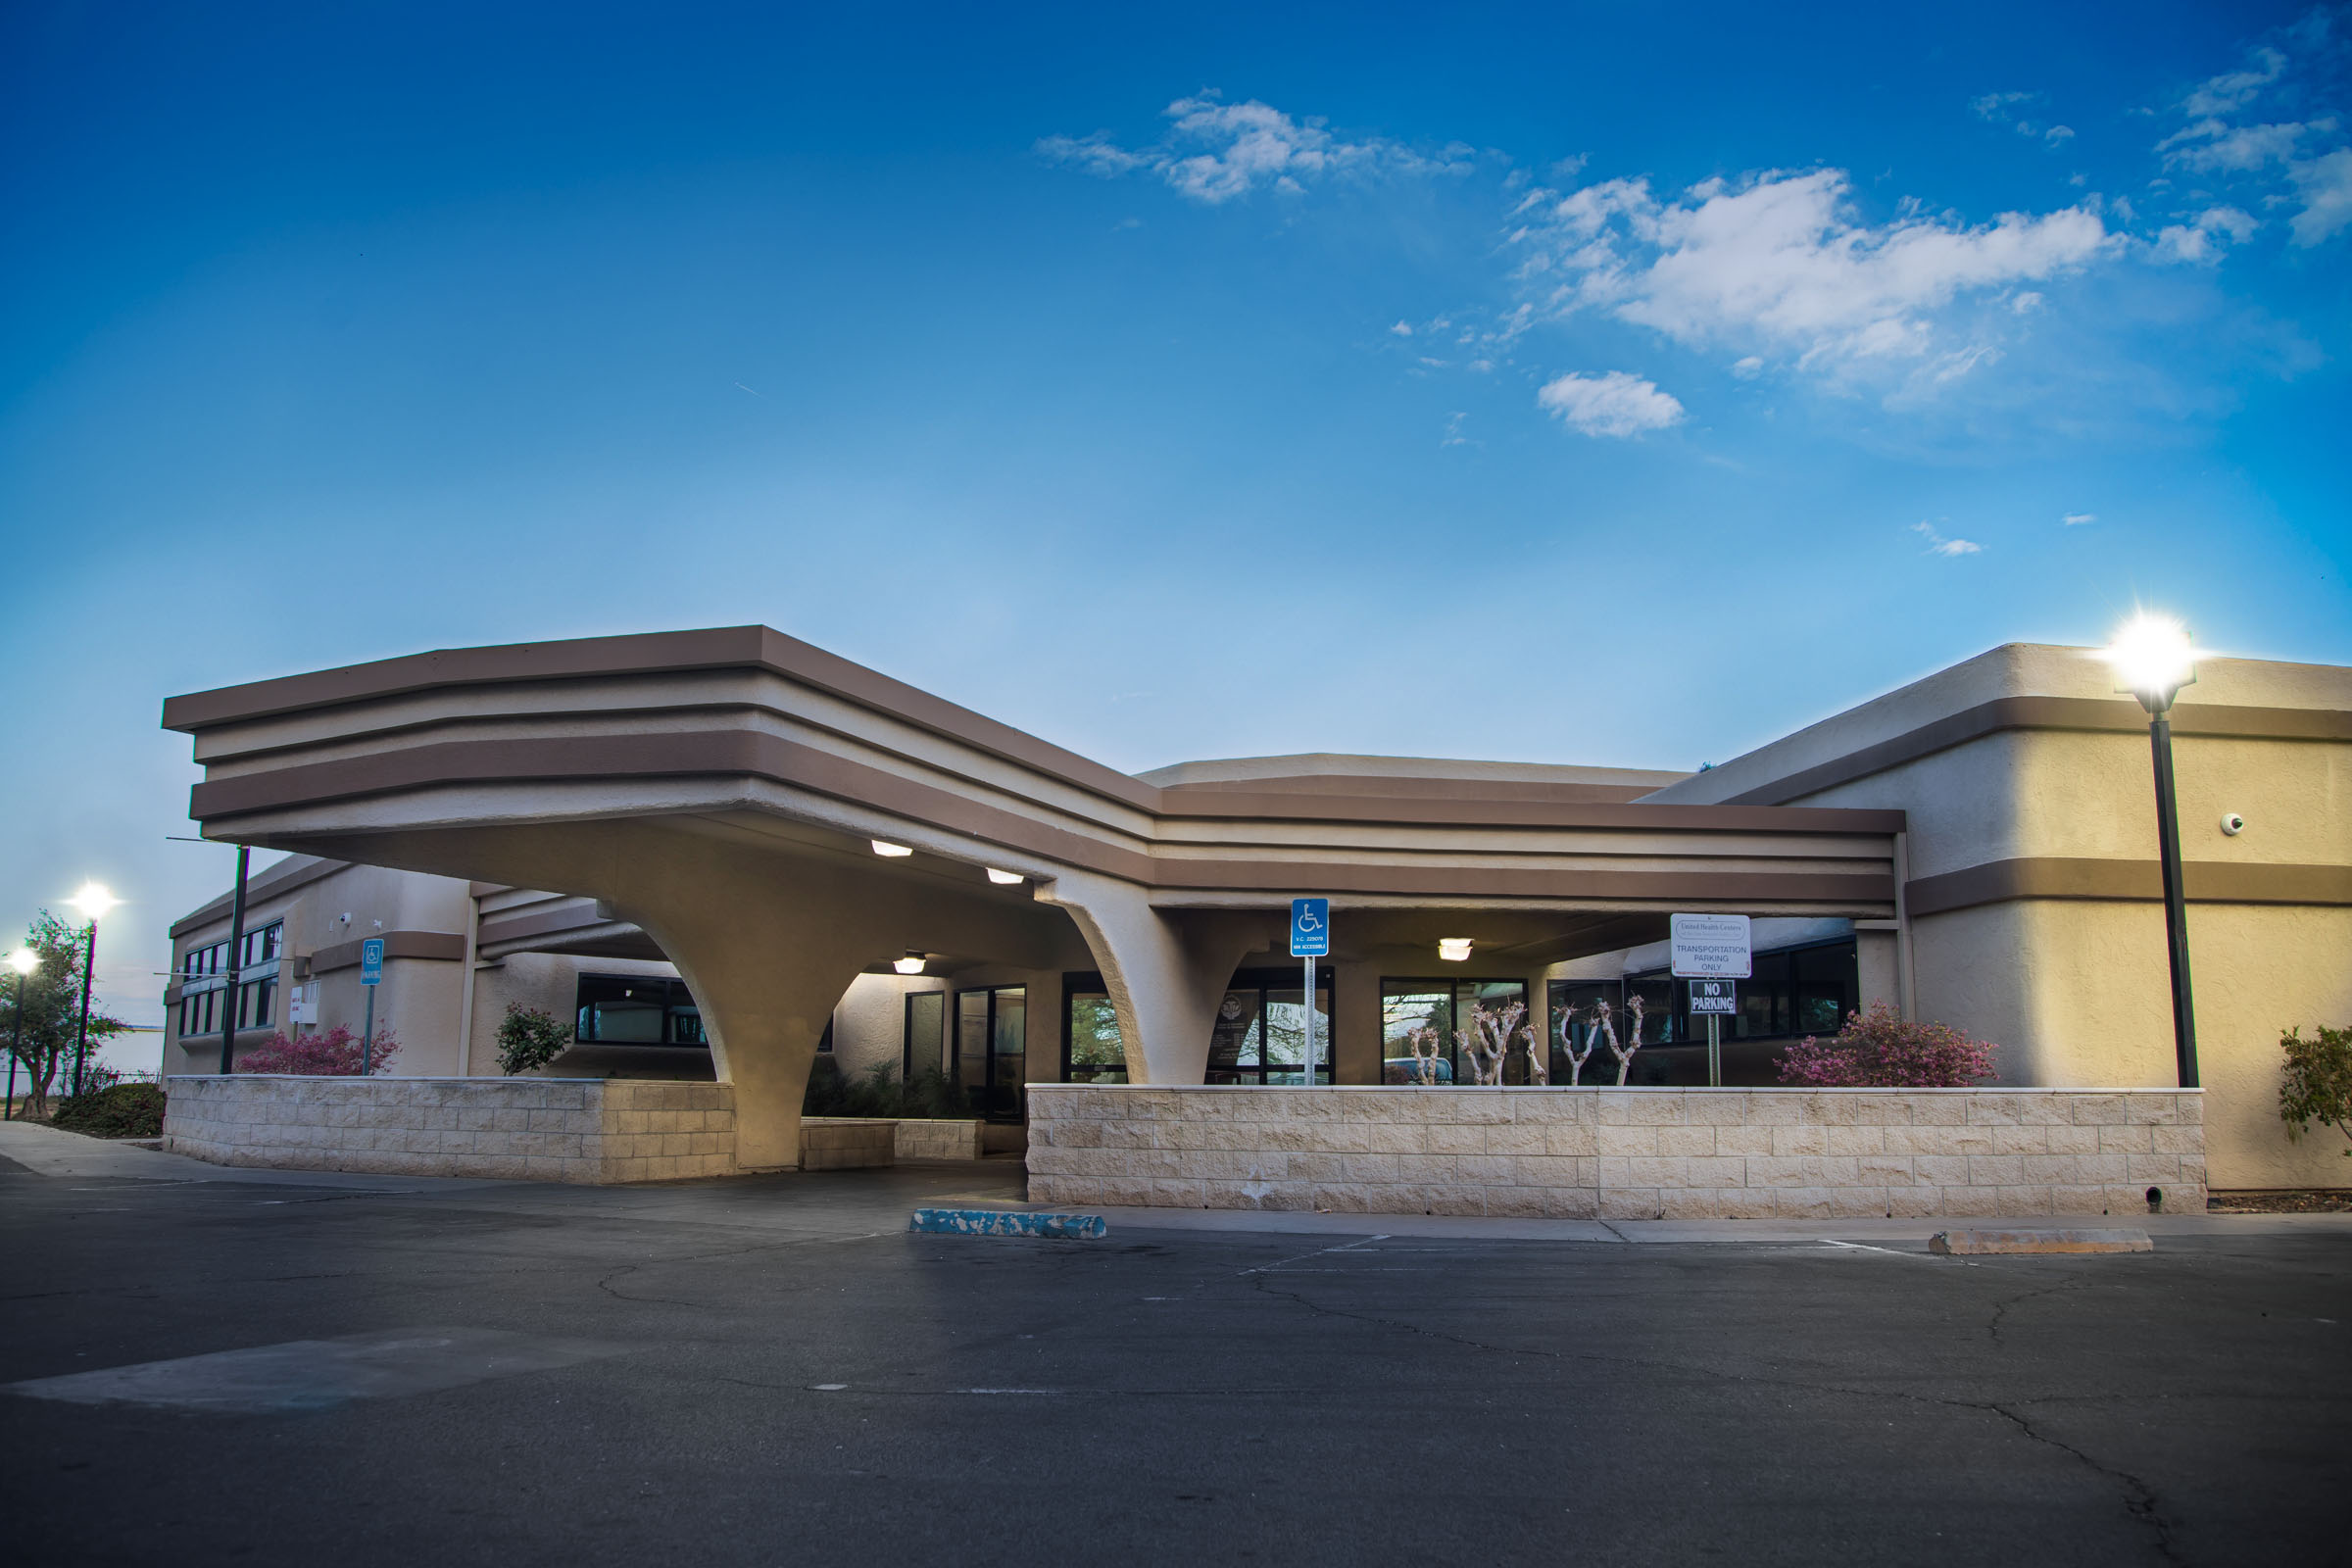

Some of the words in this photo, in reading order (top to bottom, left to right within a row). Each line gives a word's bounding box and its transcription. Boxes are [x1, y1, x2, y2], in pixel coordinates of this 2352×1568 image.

[1677, 945, 1747, 954] TRANSPORTATION
[1704, 983, 1721, 996] NO
[1692, 998, 1734, 1010] PARKING
